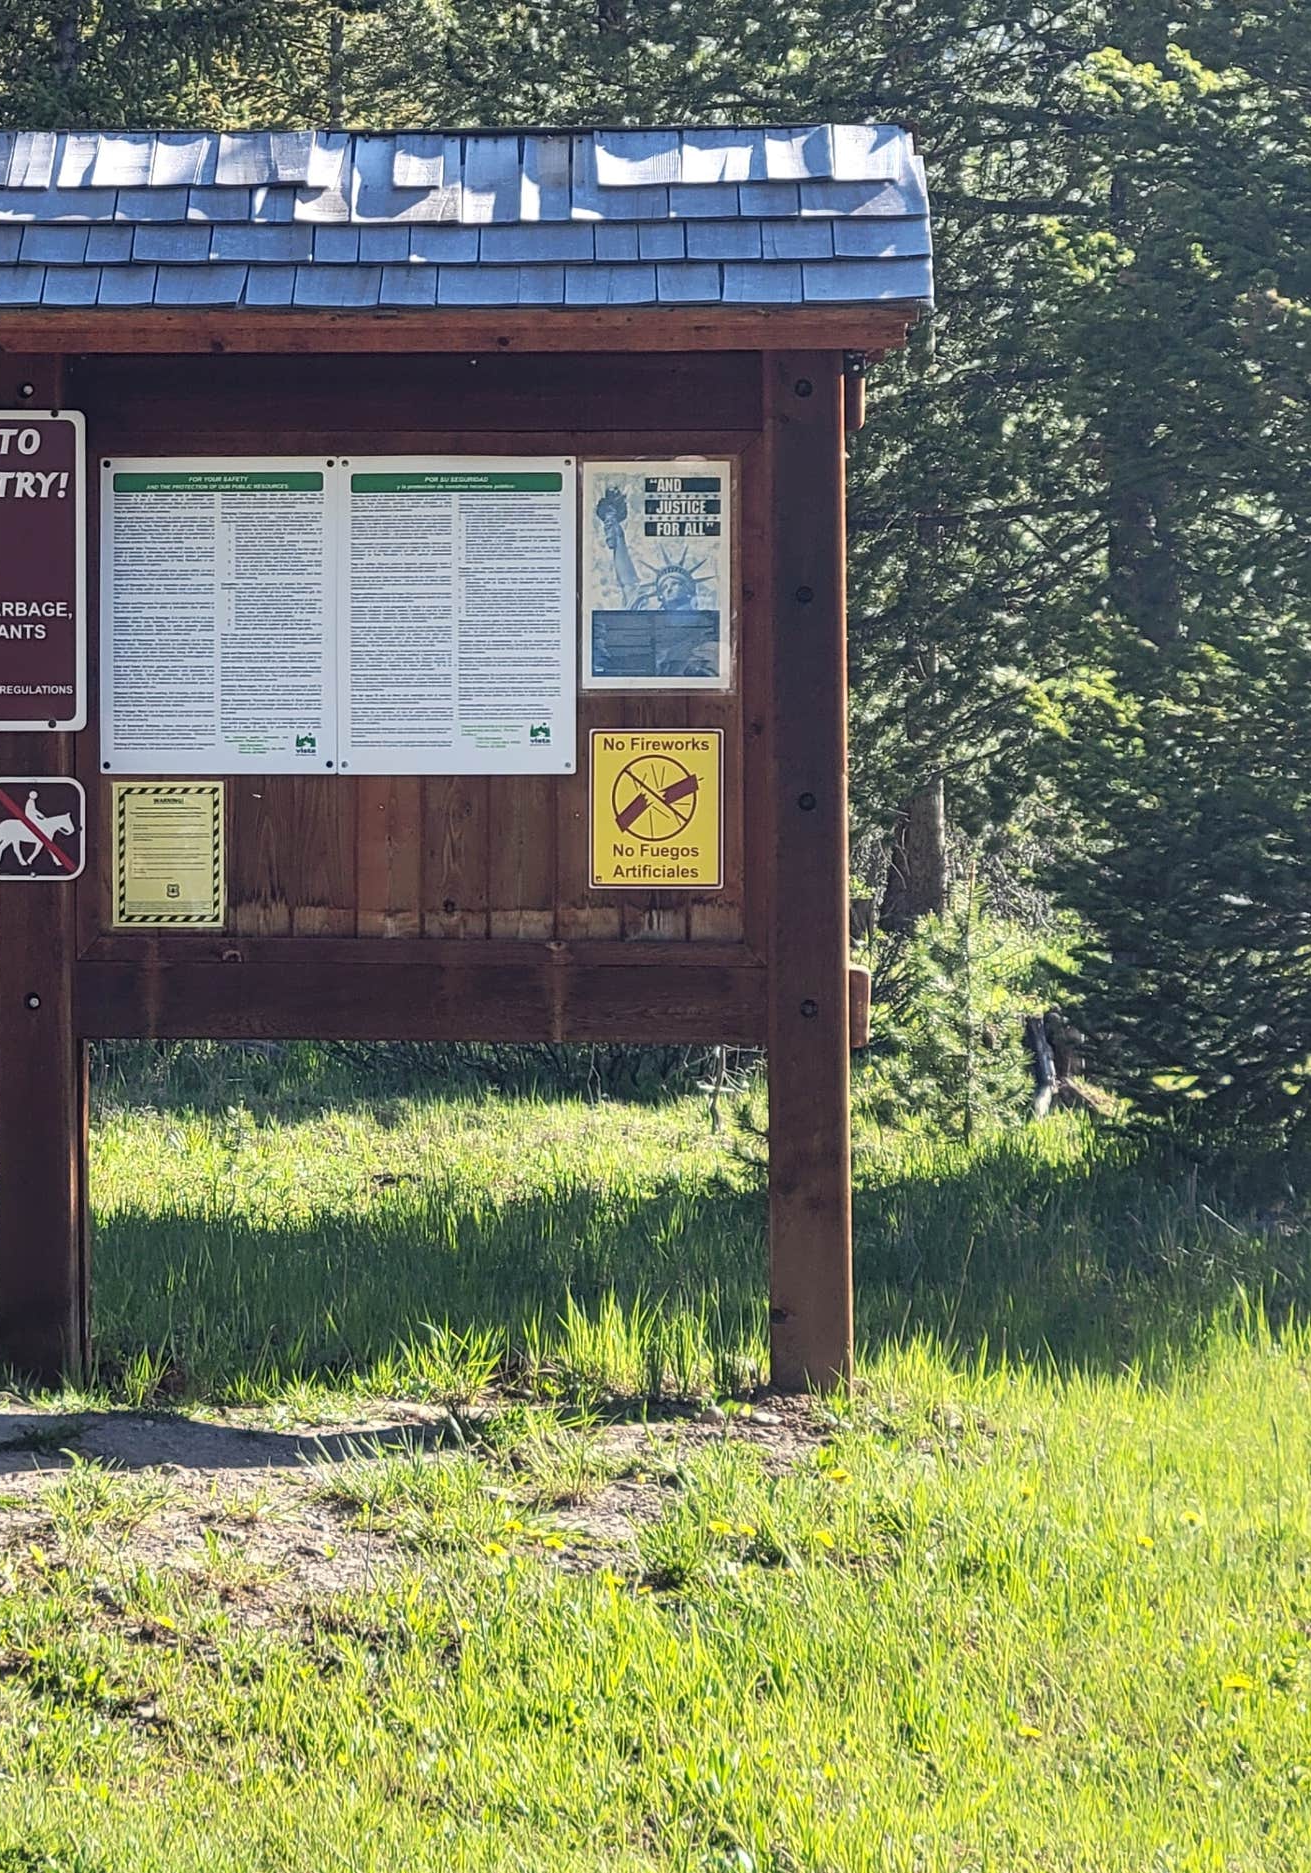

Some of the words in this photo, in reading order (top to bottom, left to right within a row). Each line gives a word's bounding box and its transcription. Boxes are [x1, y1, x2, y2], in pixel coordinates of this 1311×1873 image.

[649, 479, 682, 492] "AND
[656, 500, 706, 513] JUSTICE
[657, 522, 680, 536] FOR
[684, 522, 714, 536] ALL"
[0, 685, 73, 695] REGULATIONS
[603, 738, 625, 750] No
[631, 737, 709, 750] Fireworks
[613, 844, 635, 857] No
[640, 844, 699, 860] Fuegos
[613, 864, 699, 878] Artificiales
